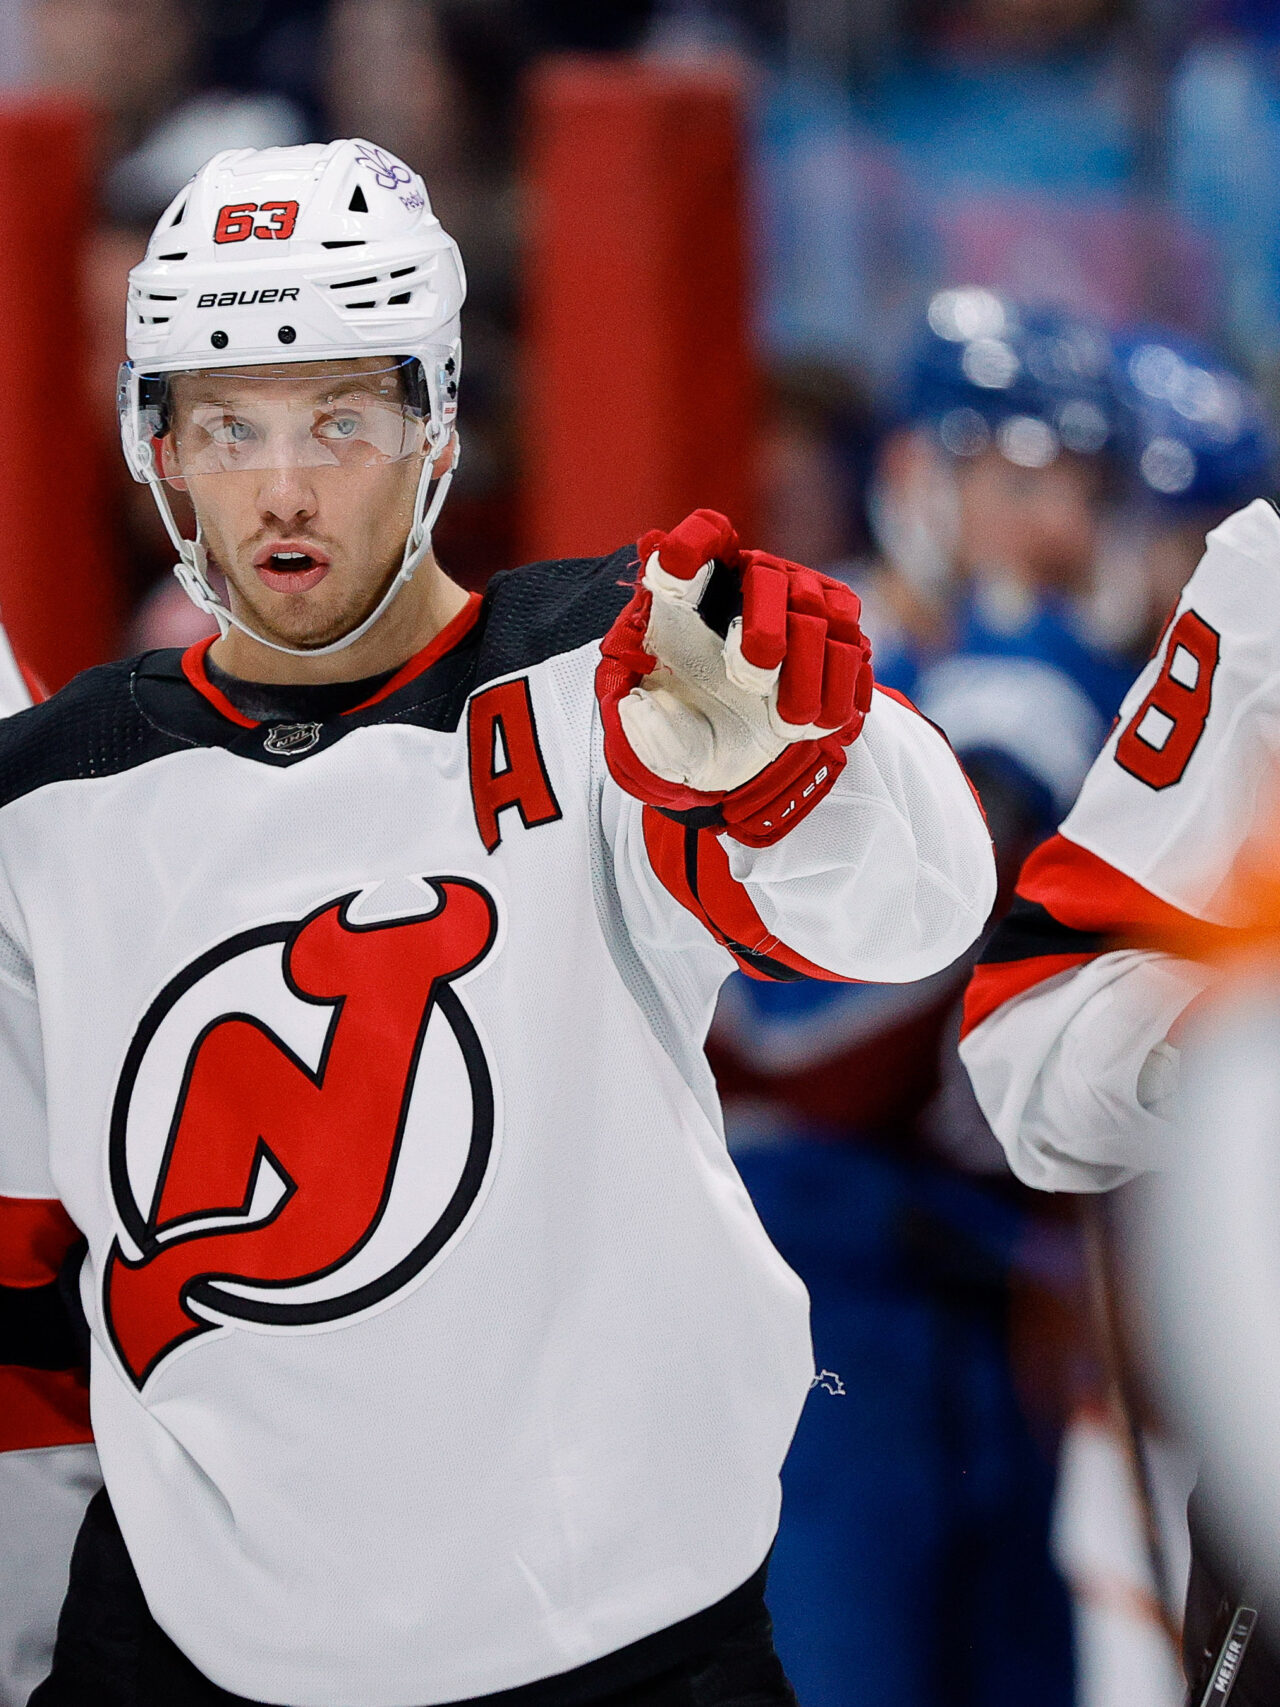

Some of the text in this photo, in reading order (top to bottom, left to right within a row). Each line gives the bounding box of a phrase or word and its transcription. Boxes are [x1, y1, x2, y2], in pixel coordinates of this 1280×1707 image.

[212, 200, 300, 244] 63
[276, 730, 309, 748] NHL
[1108, 592, 1220, 791] 8
[467, 676, 563, 856] A
